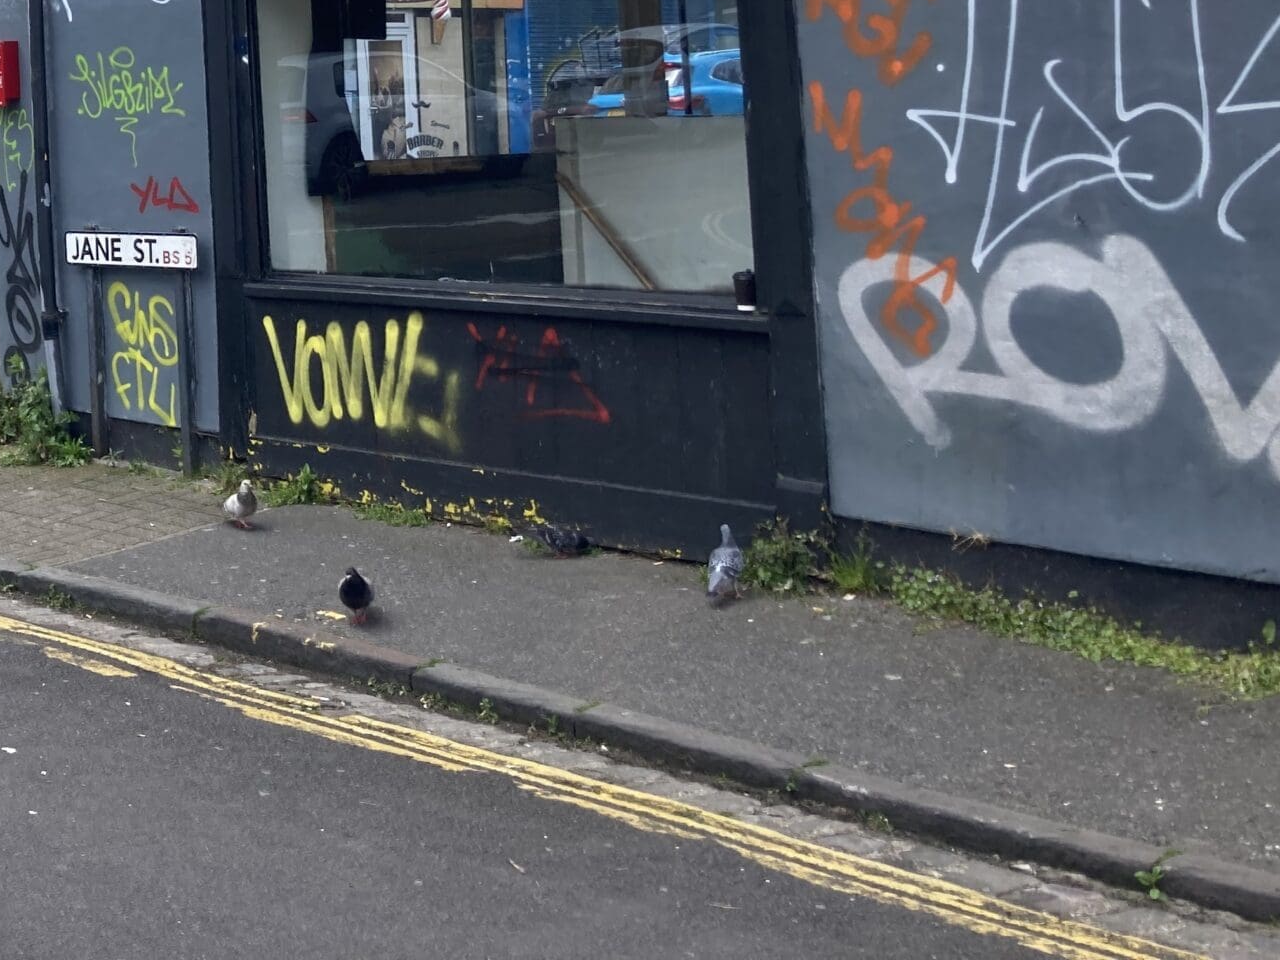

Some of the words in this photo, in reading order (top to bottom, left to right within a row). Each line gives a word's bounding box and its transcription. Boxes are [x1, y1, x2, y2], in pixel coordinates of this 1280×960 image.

[71, 237, 122, 262] JANE
[133, 238, 160, 264] ST.
[163, 250, 180, 265] BS
